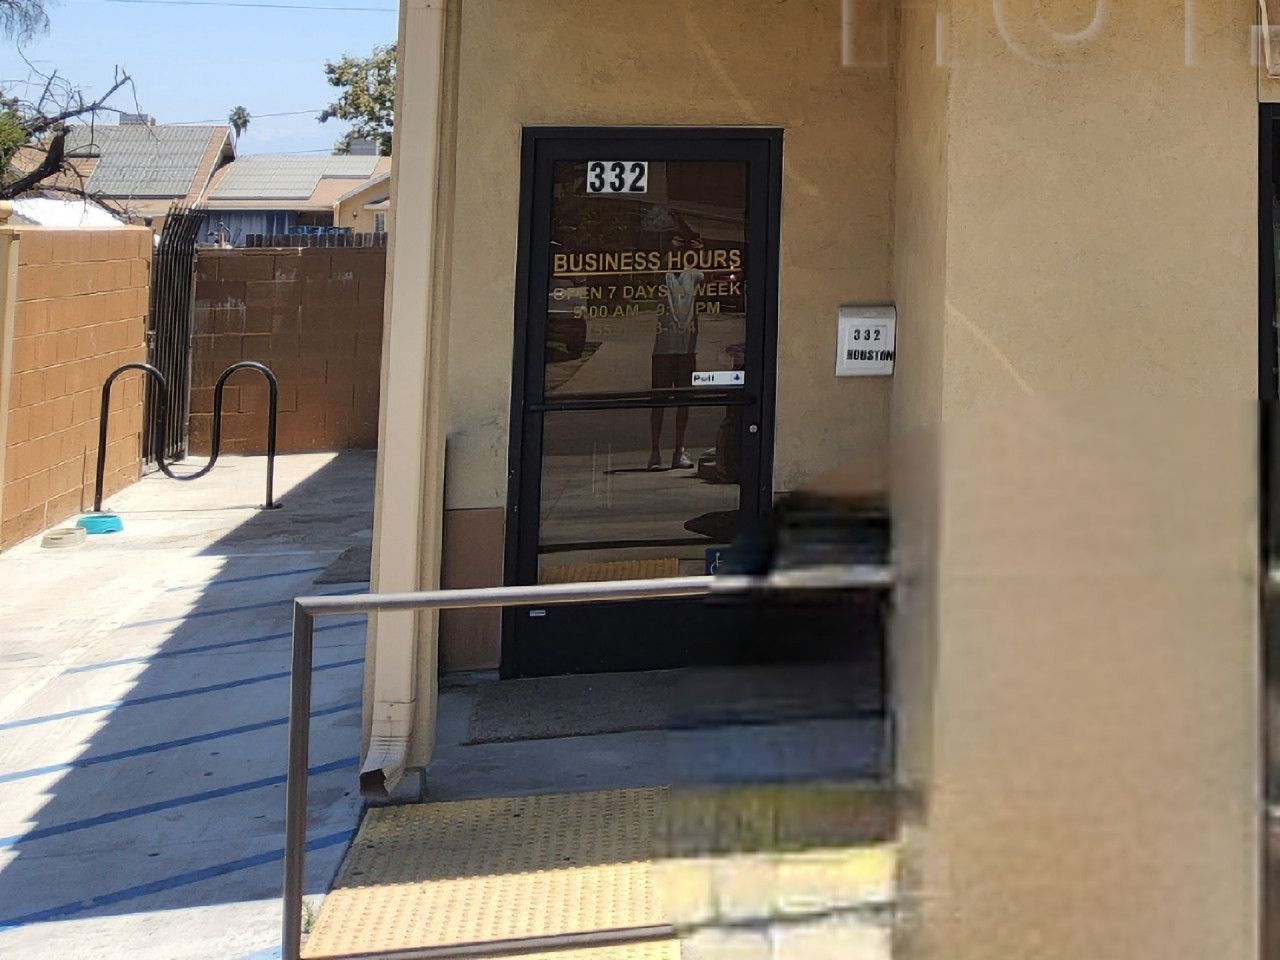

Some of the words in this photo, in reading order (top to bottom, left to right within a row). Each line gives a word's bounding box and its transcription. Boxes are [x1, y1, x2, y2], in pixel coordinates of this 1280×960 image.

[590, 161, 645, 192] 332
[553, 251, 661, 273] BUSINESS
[667, 249, 742, 269] HOURS
[608, 286, 617, 299] 7
[623, 284, 668, 299] DAYS
[692, 281, 742, 296] WEEK
[612, 304, 640, 318] AM
[695, 301, 721, 315] PM
[846, 349, 895, 362] HOUSTON
